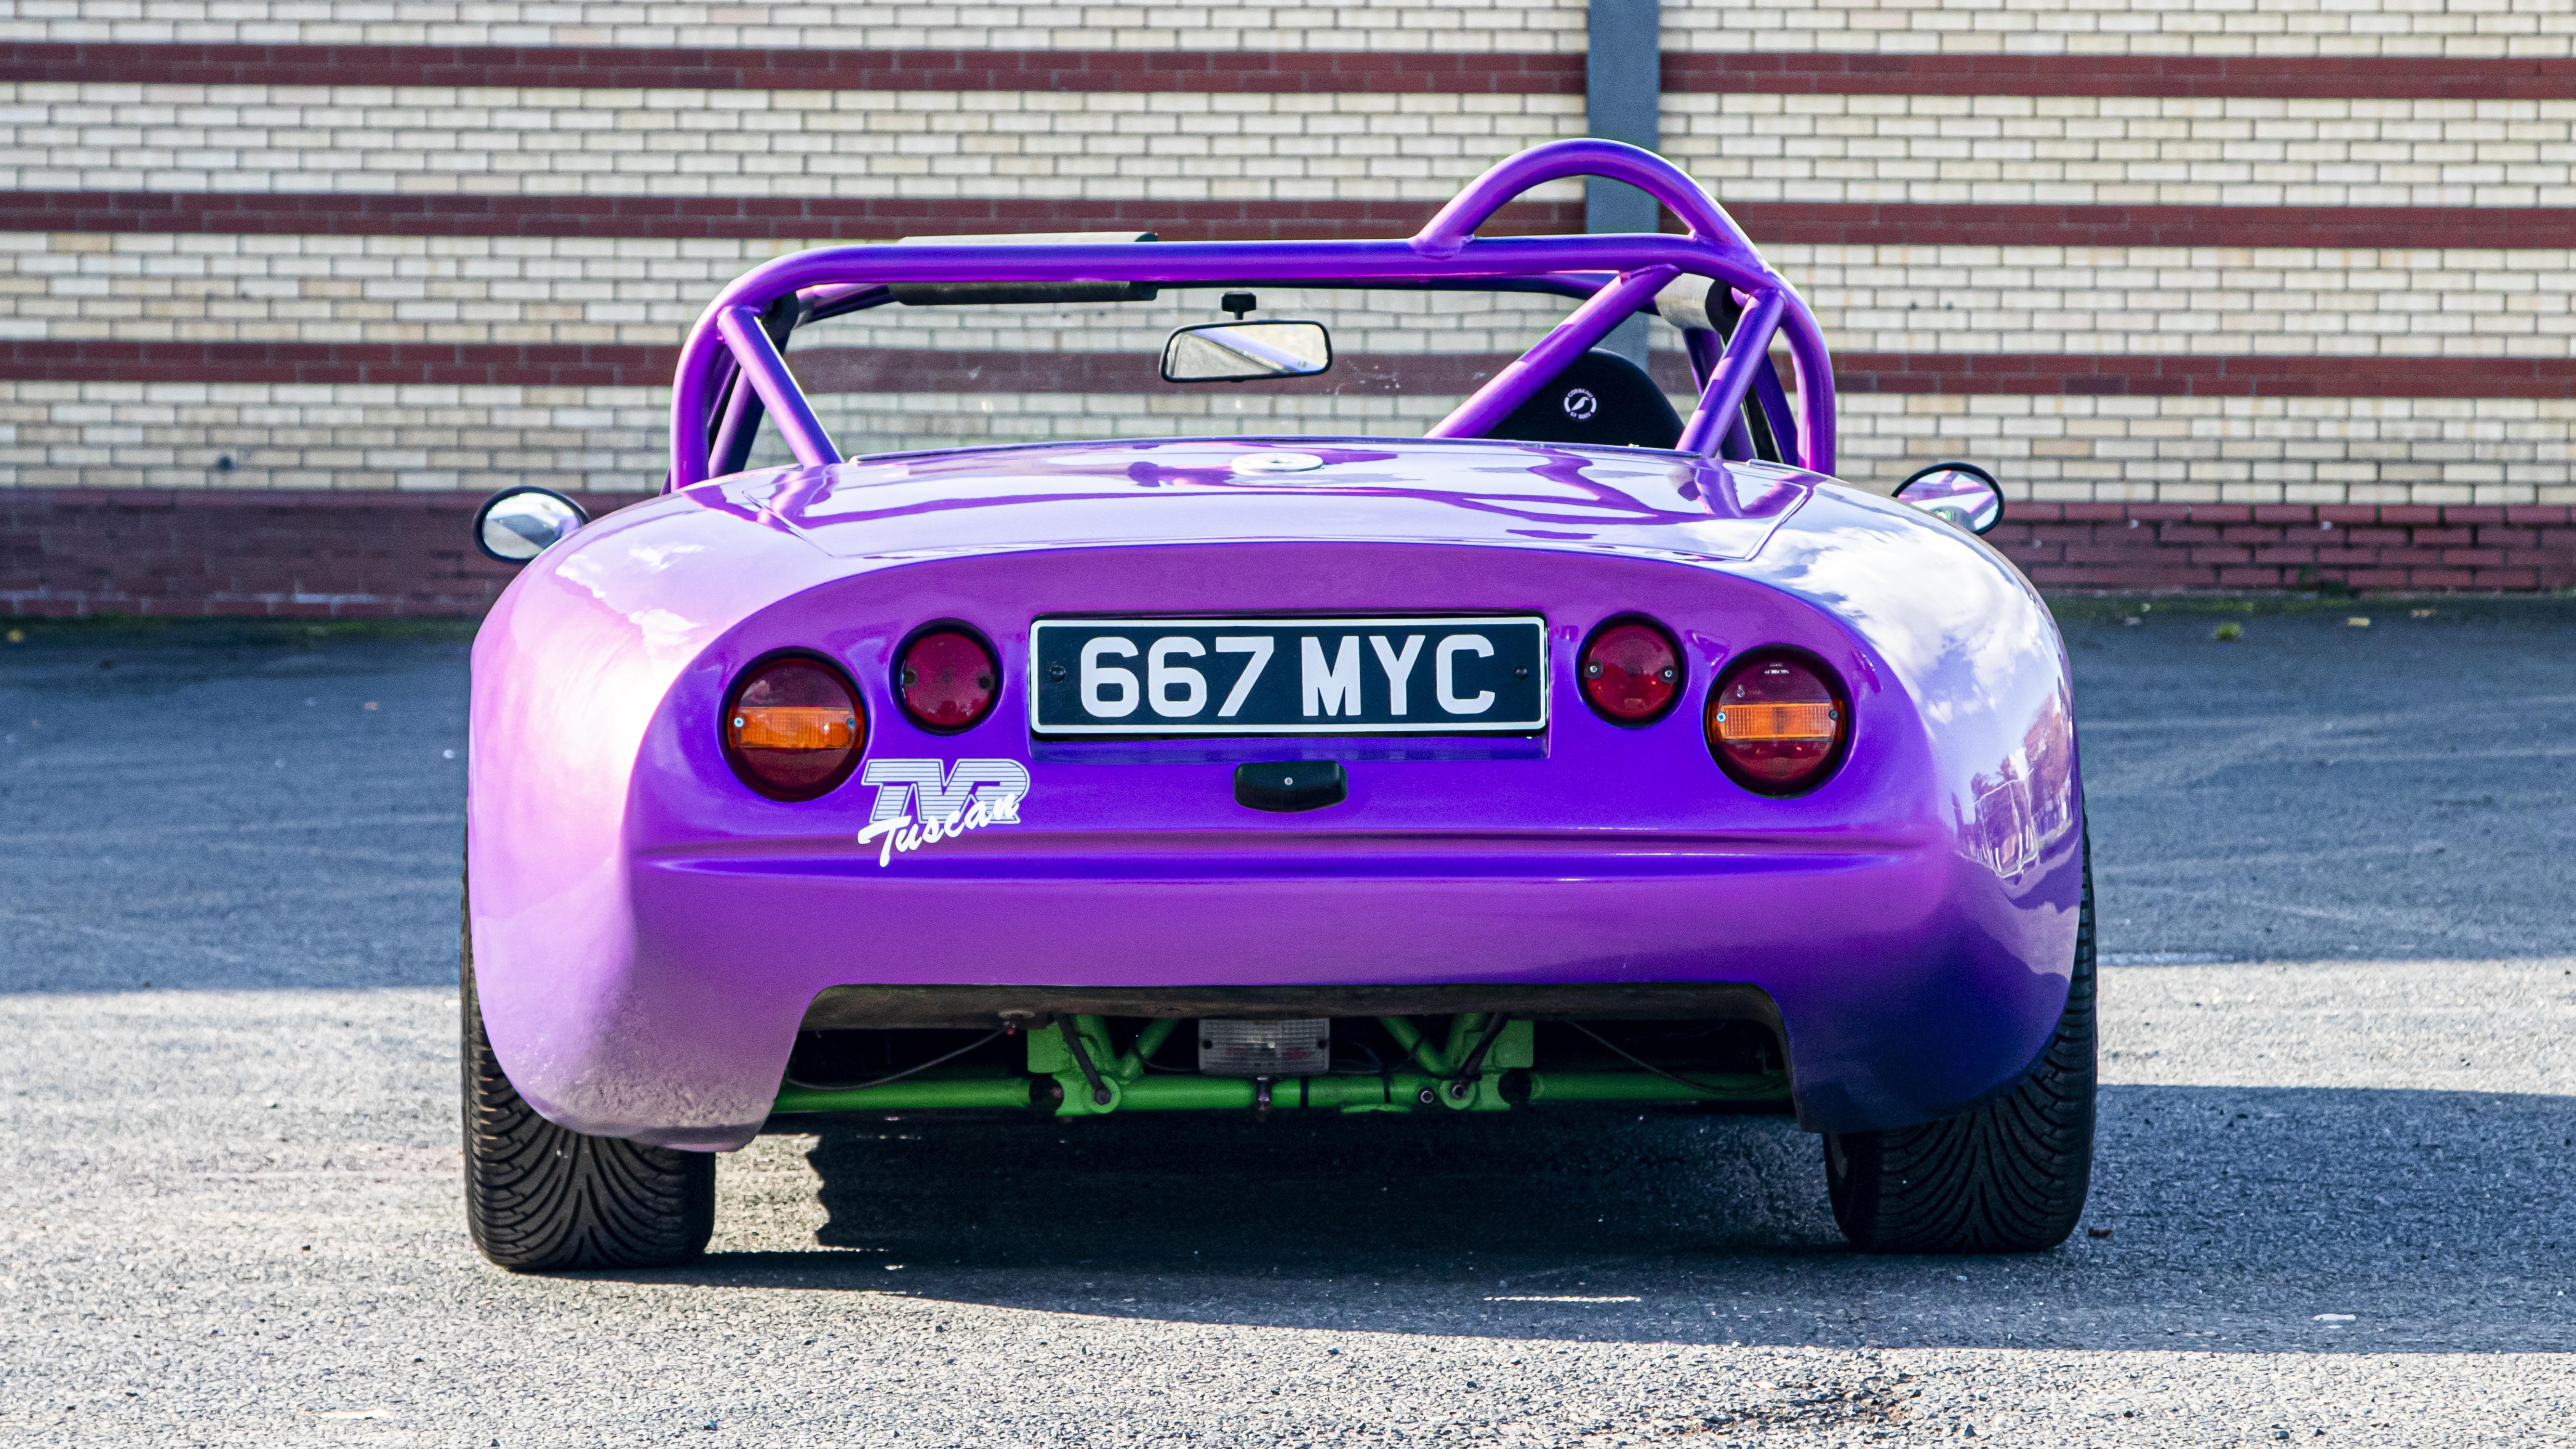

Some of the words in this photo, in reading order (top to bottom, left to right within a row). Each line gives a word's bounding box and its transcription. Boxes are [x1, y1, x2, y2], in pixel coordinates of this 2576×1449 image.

[1080, 636, 1275, 717] 667
[1301, 634, 1496, 716] MYC
[861, 758, 1030, 824] TVR
[858, 792, 1020, 867] Tuscan
